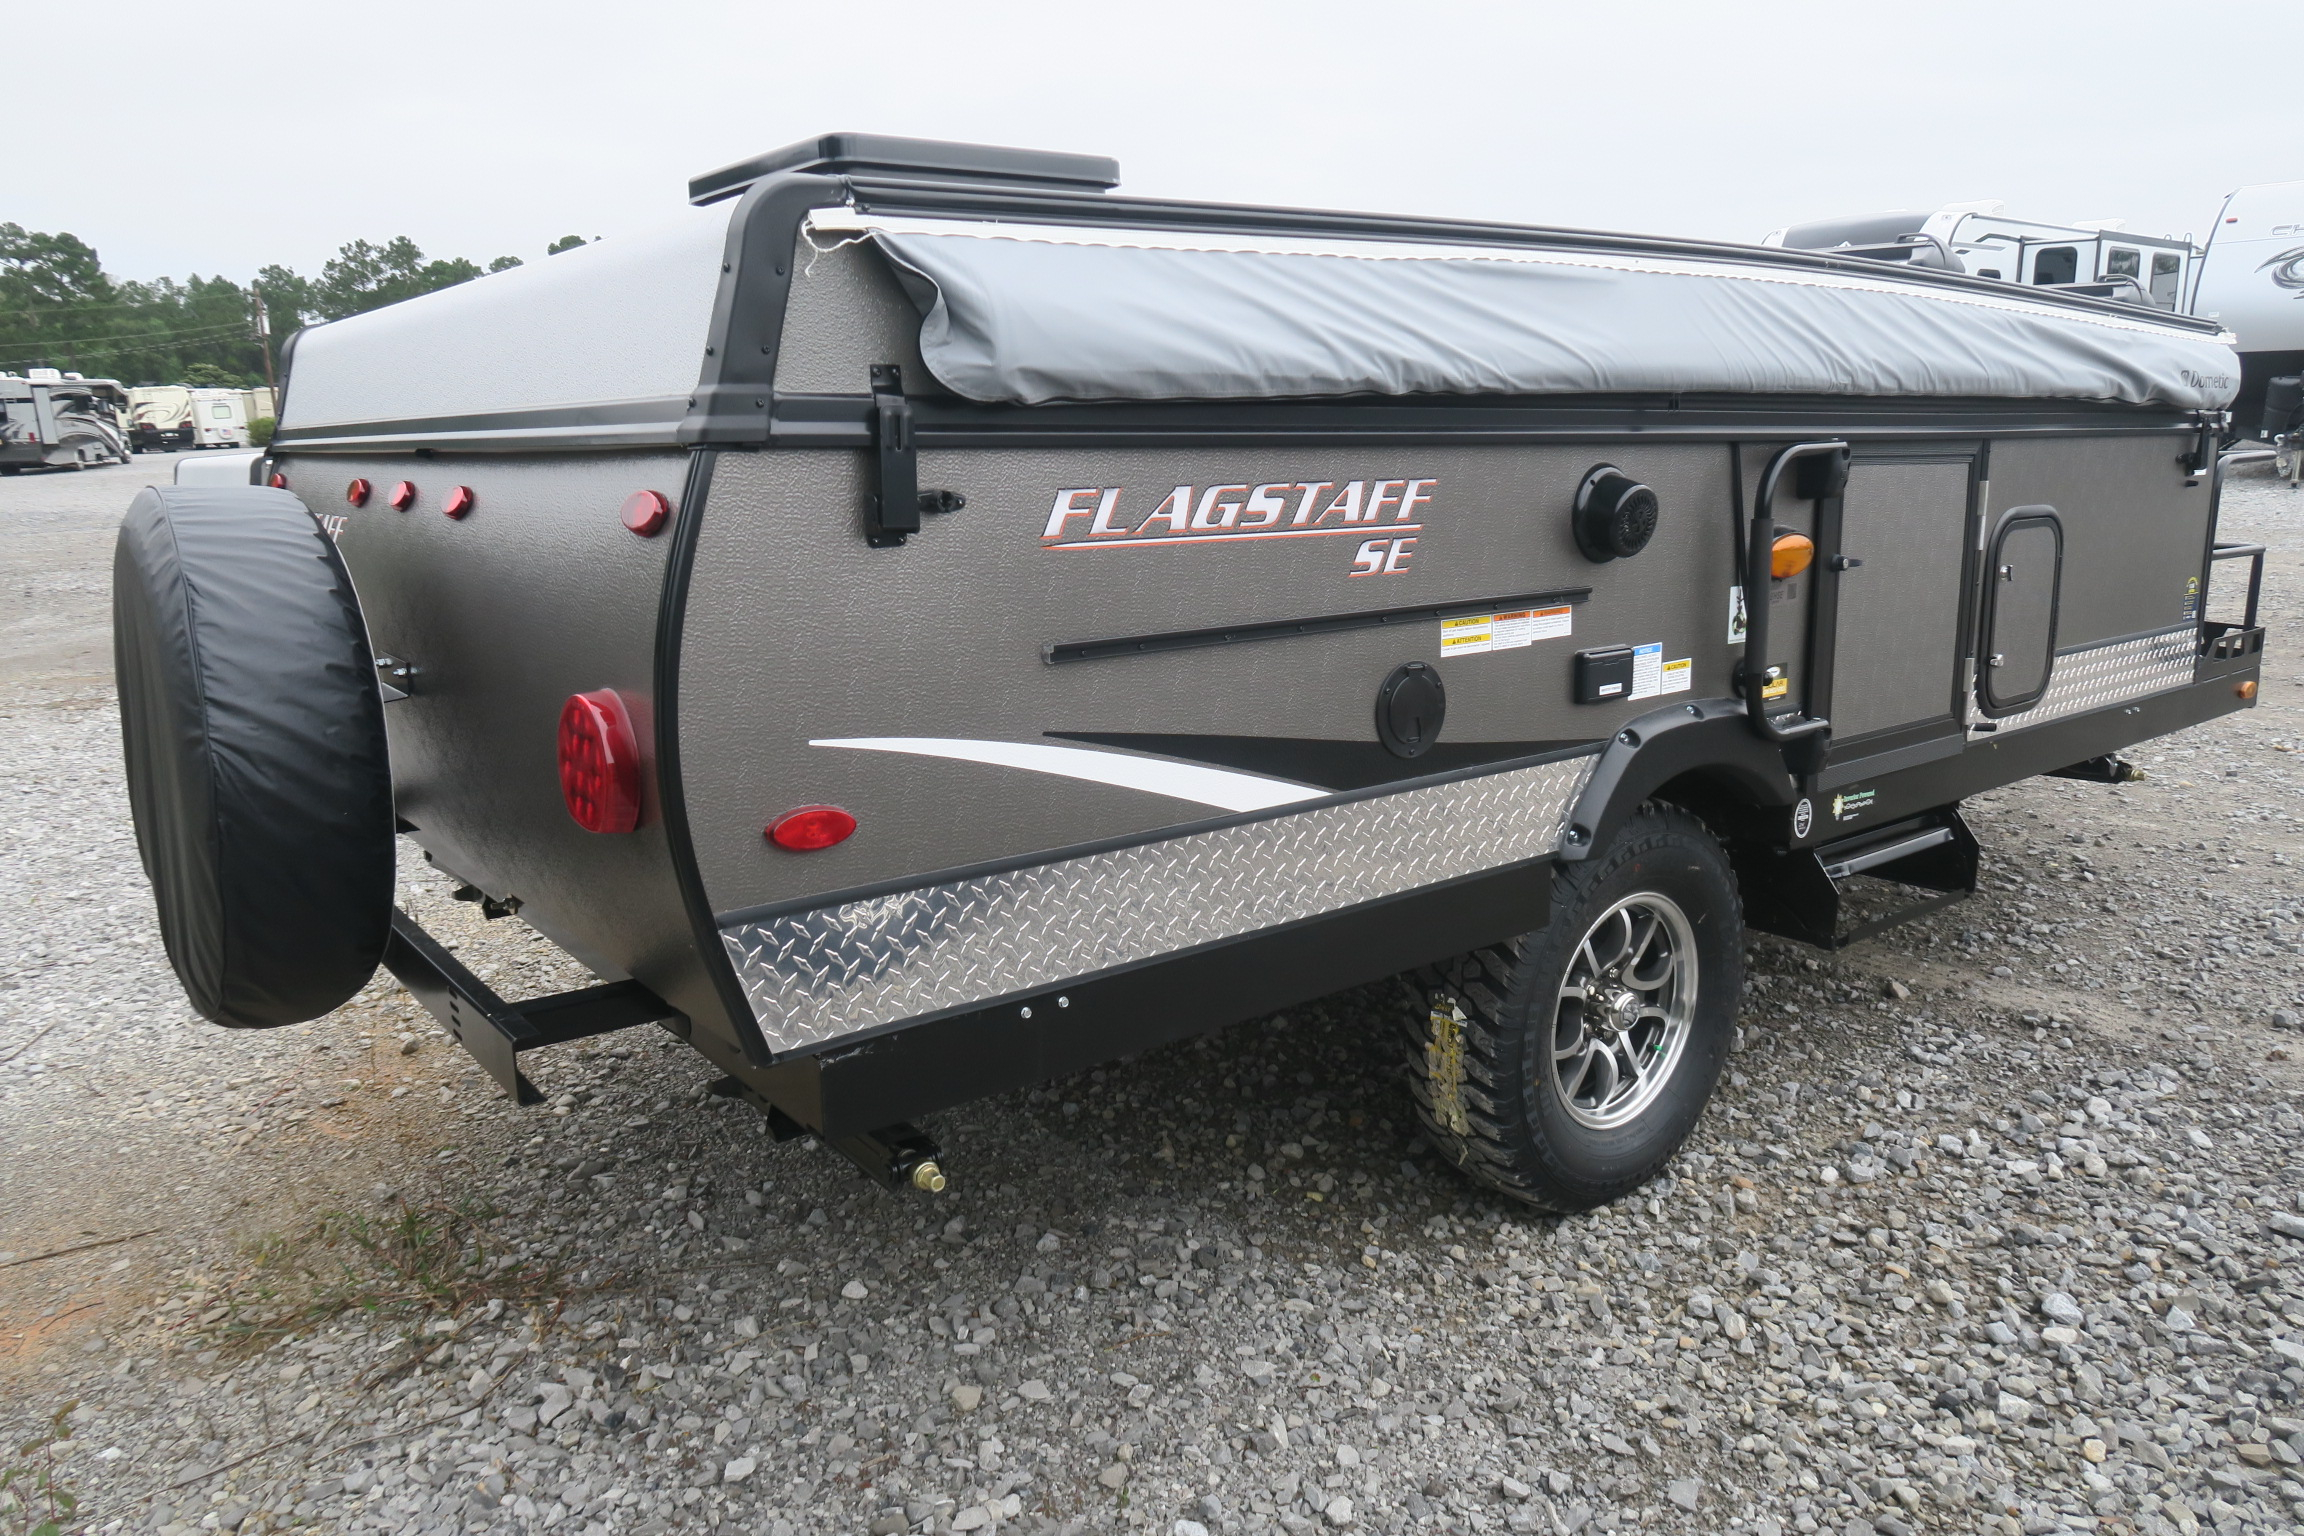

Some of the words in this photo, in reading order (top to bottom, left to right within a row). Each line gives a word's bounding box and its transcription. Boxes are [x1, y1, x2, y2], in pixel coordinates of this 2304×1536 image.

[2190, 370, 2230, 389] Dometic
[1040, 478, 1438, 540] FLAGSTAFF
[1349, 536, 1418, 577] SE
[1459, 618, 1480, 626] CAUTION
[1457, 635, 1482, 643] ATTENTION
